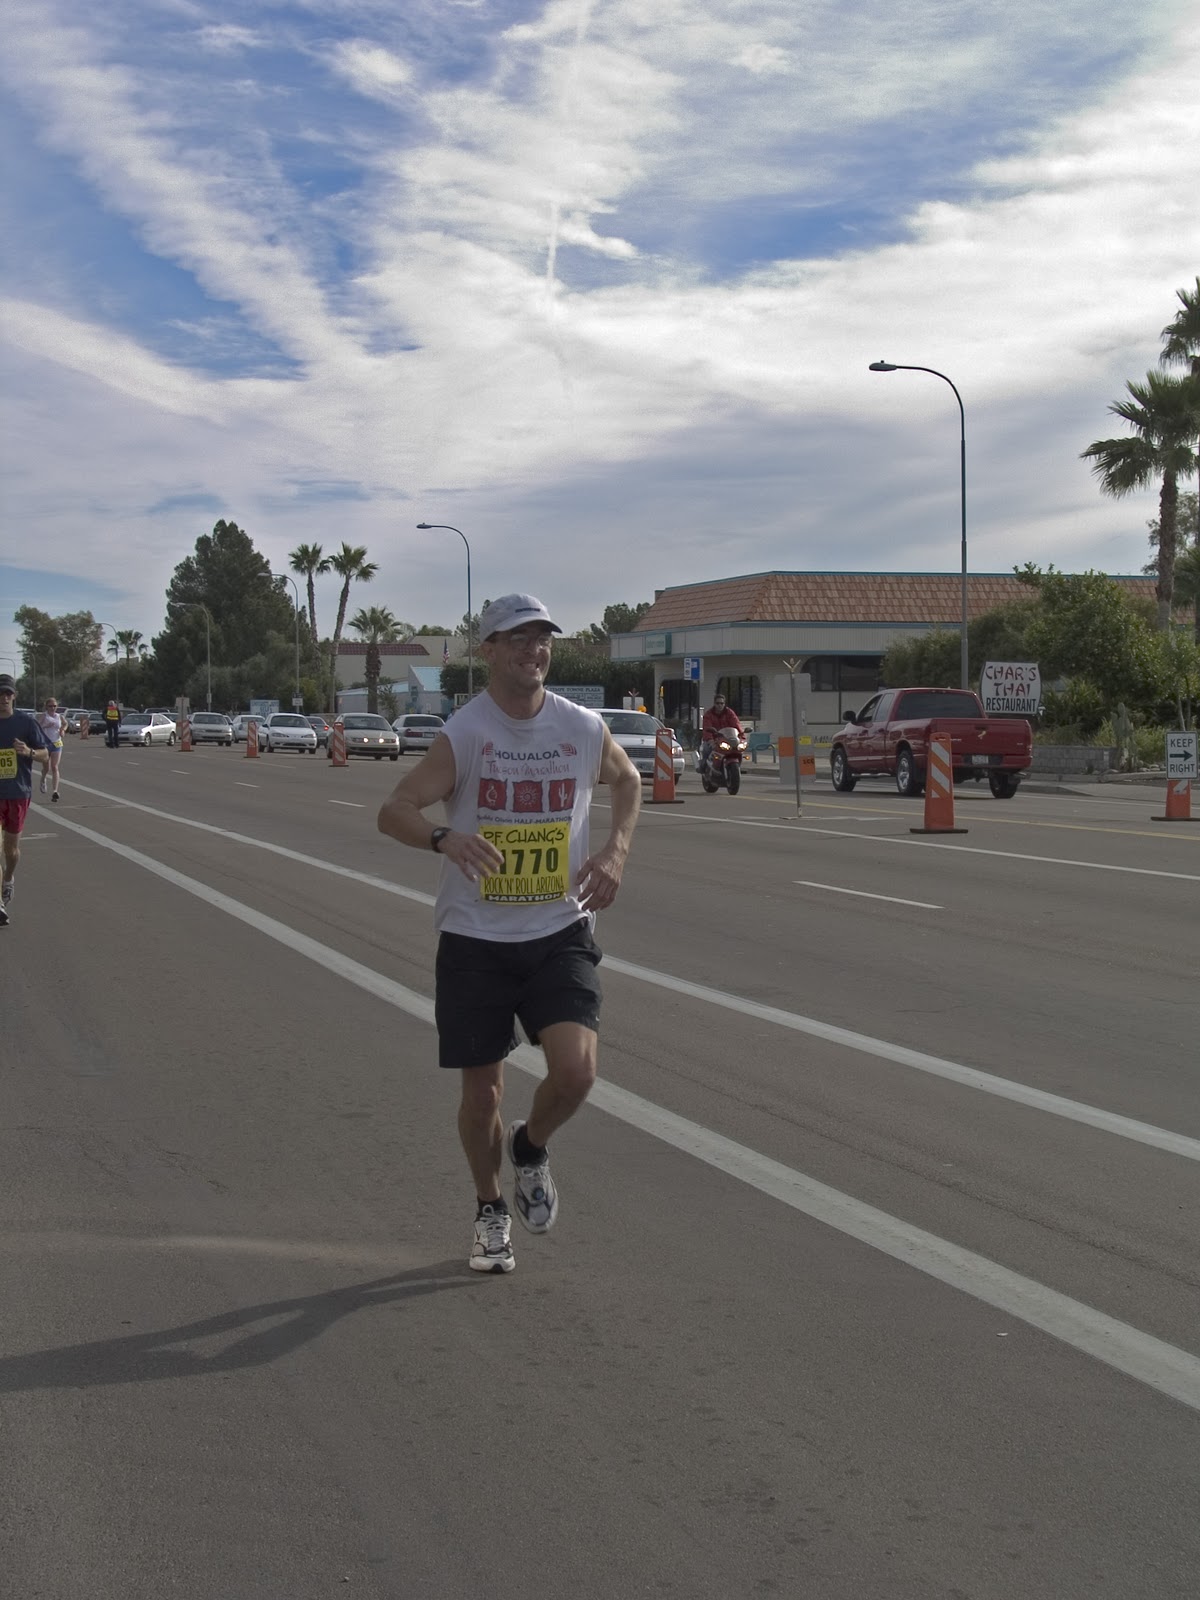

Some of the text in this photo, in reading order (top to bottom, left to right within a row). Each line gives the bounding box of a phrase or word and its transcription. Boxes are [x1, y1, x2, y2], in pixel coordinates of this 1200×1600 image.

[985, 665, 1037, 681] CHAR'S
[993, 682, 1031, 697] THAI
[985, 697, 1037, 712] RESTAURANT
[1170, 738, 1194, 748] KEEP
[494, 749, 561, 761] HOLUALOA
[520, 760, 570, 777] Marathon
[1169, 763, 1196, 773] RIGHT
[505, 827, 565, 845] CHANG'S
[484, 876, 503, 894] ROCK
[515, 877, 535, 894] ROLL
[535, 874, 565, 894] ARIZONA
[488, 892, 561, 902] MARATHON
